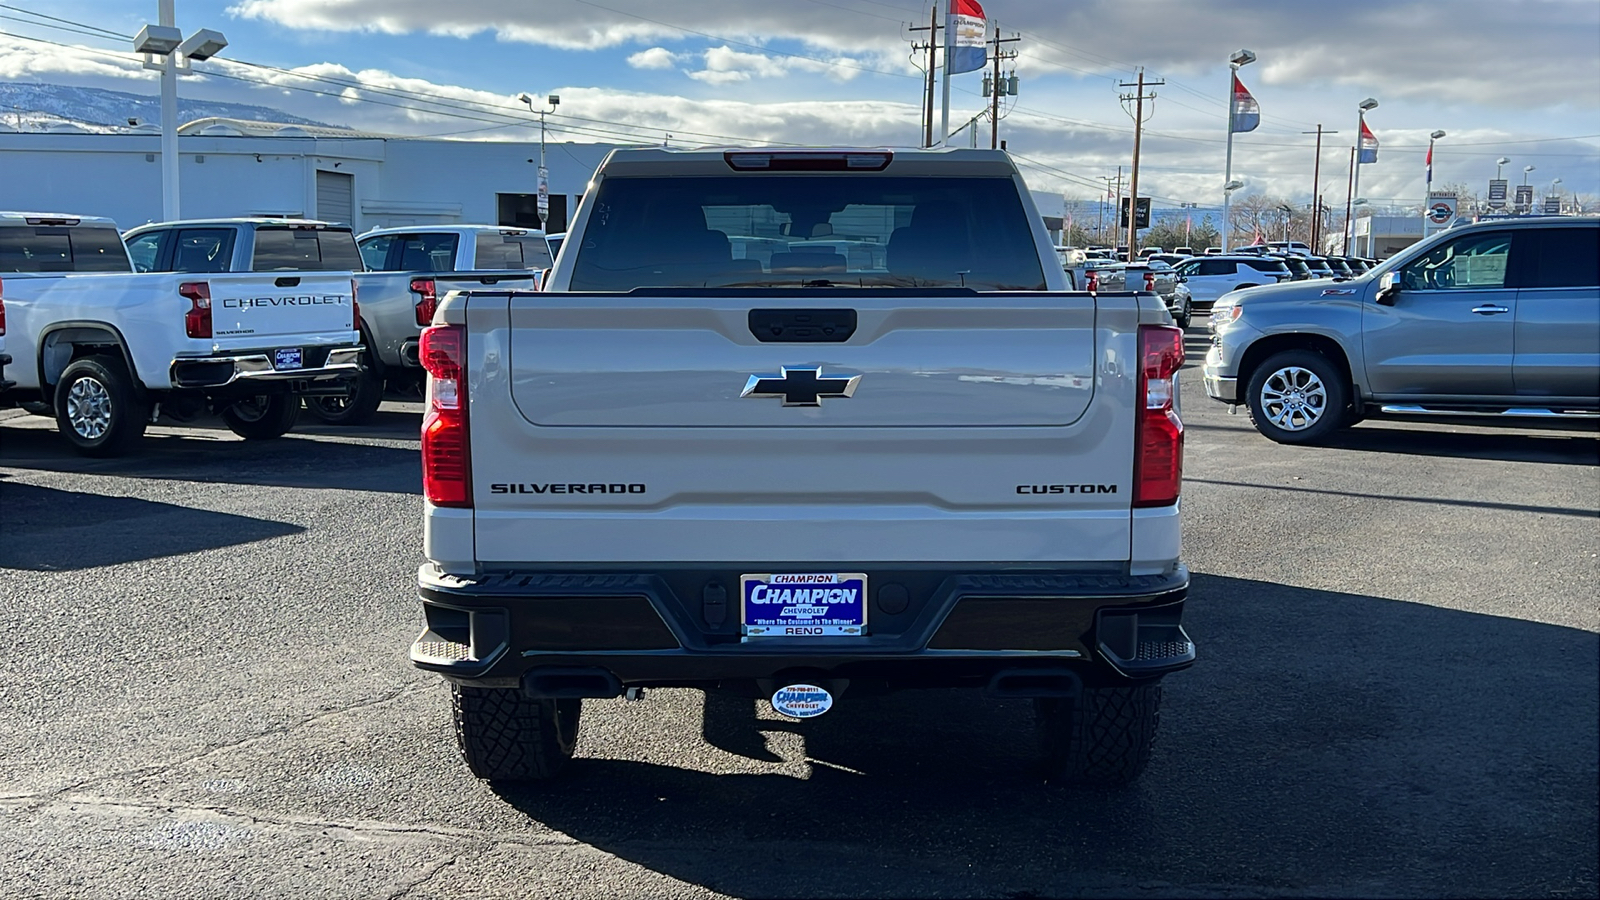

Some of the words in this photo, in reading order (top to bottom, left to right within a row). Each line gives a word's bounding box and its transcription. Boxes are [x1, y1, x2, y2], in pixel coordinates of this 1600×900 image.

[223, 295, 345, 308] CHEVROLET
[491, 483, 646, 494] SILVERADO
[1016, 484, 1118, 495] CUSTOM
[775, 575, 833, 583] CHAMPION
[750, 585, 857, 604] CHAMPION
[783, 607, 825, 615] CHEVROLET
[785, 627, 823, 635] RENO
